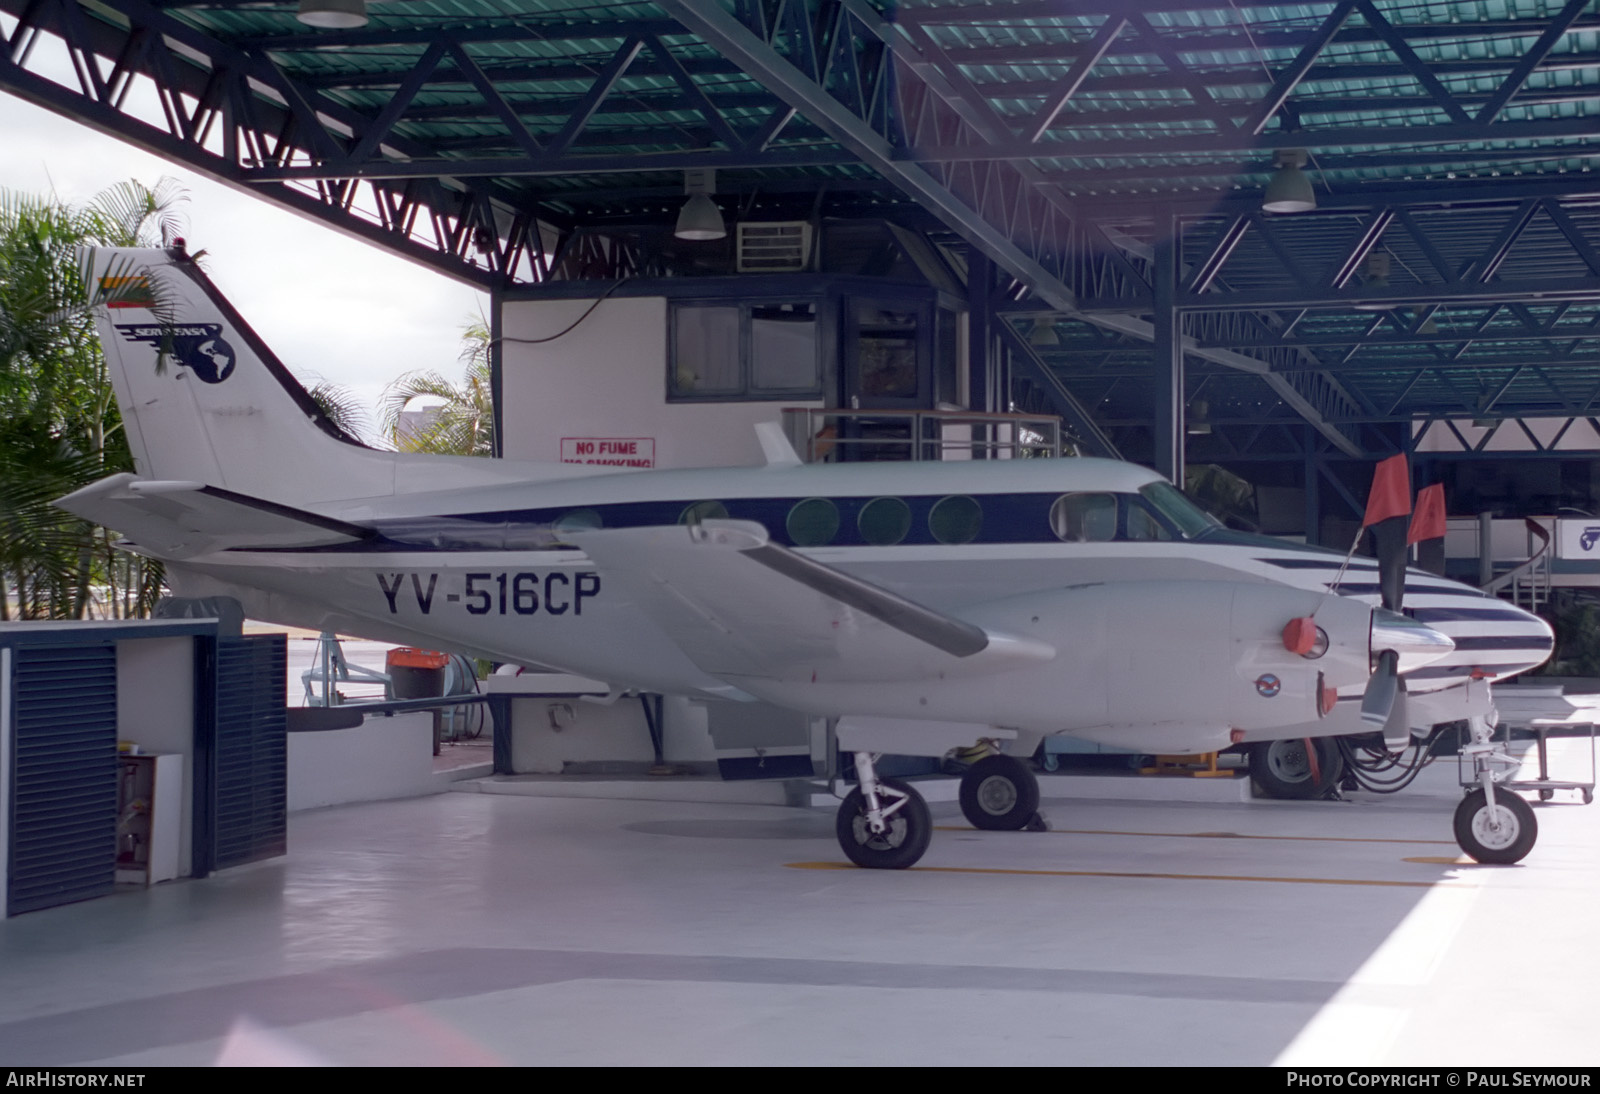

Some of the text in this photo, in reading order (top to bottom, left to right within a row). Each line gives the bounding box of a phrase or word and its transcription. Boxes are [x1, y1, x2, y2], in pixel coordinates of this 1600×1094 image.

[134, 327, 208, 337] SERVENSA
[576, 442, 637, 455] NO FUME
[376, 571, 601, 616] YV-516CP
